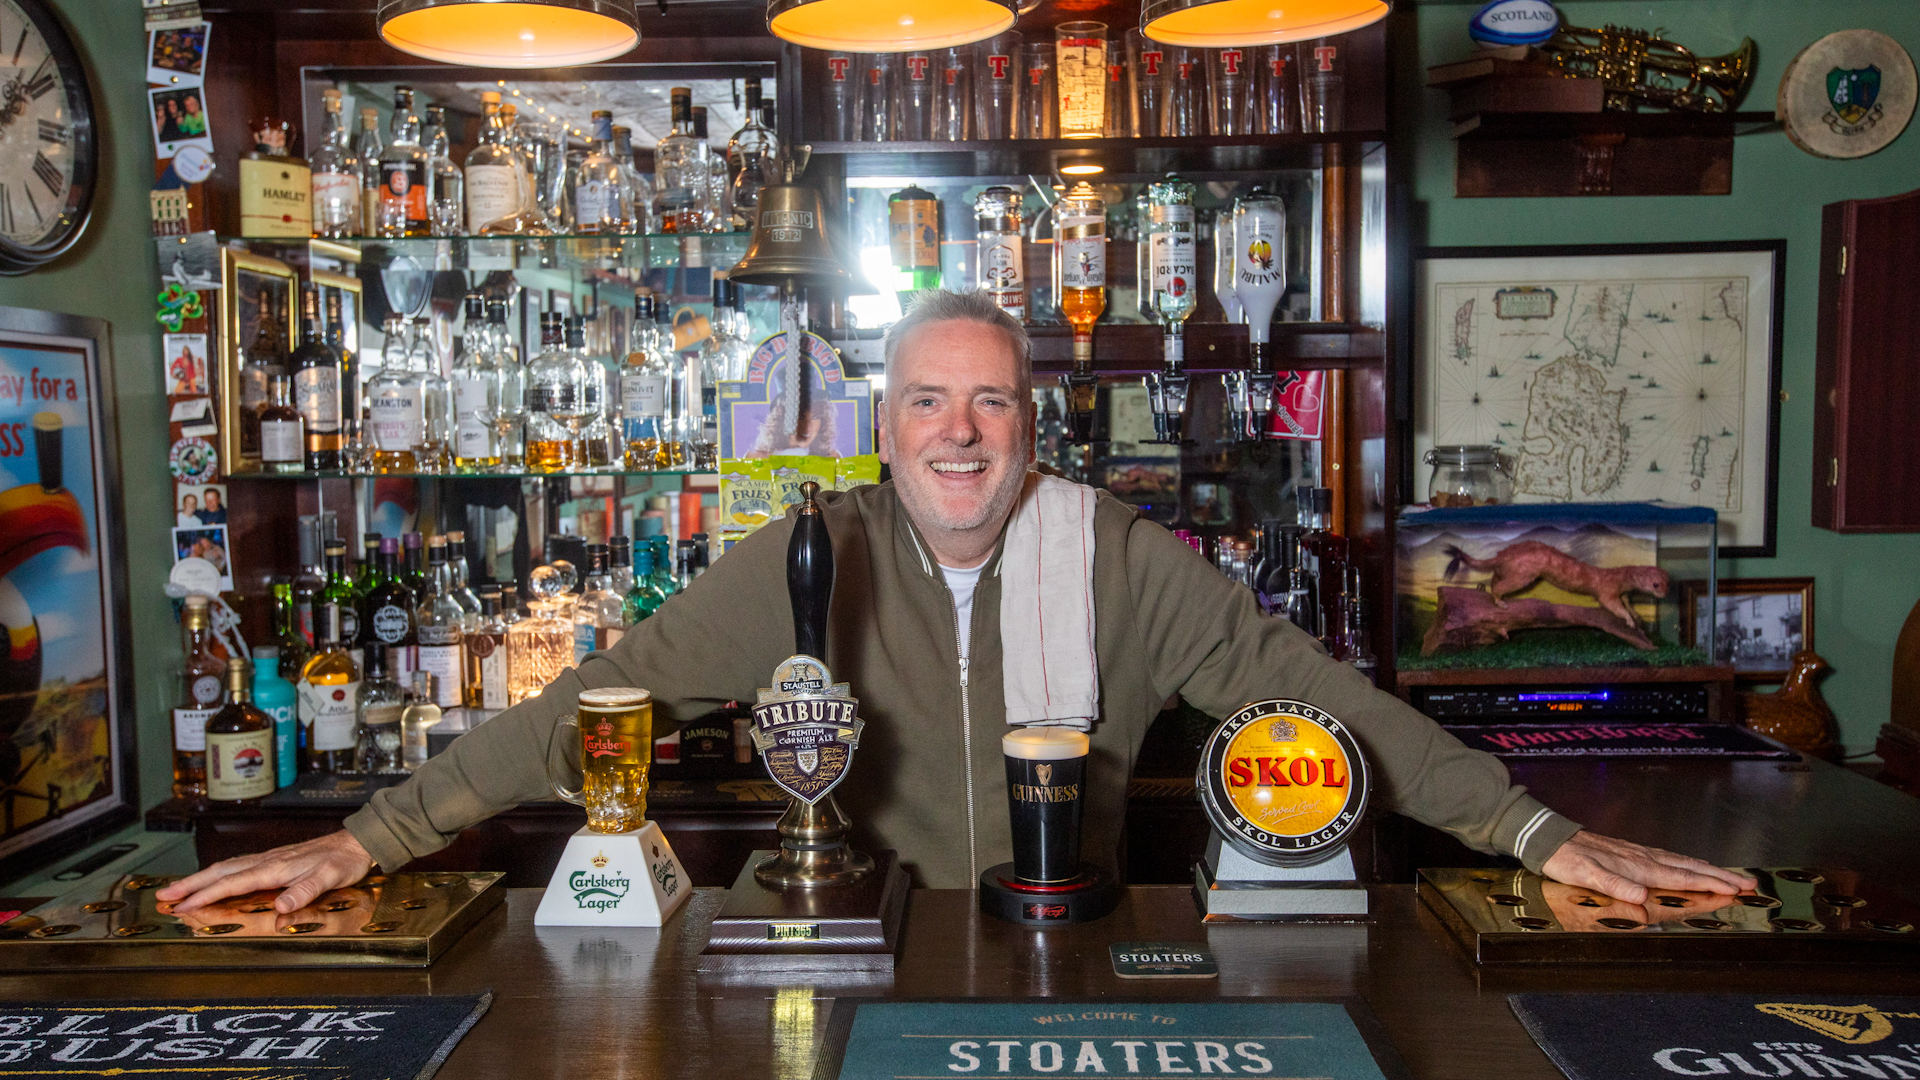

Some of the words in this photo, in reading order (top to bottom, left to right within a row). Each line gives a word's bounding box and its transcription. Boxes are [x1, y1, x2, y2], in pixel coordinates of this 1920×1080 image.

[1491, 10, 1553, 22] SCOTLAND
[907, 56, 929, 80] T
[988, 55, 1009, 80] T
[1141, 51, 1162, 76] T
[1221, 50, 1242, 75] T
[1271, 59, 1286, 77] T
[1314, 46, 1336, 72] T
[828, 57, 849, 82] T
[868, 68, 882, 85] T
[945, 68, 958, 85] T
[1028, 68, 1043, 85] T
[1107, 64, 1122, 82] T
[1179, 63, 1192, 80] T
[263, 188, 306, 203] HAMLET
[764, 211, 811, 226] TITANIC
[774, 231, 799, 240] 1912
[1240, 268, 1280, 284] MALIBU
[750, 347, 774, 384] BIG
[770, 336, 787, 355] D
[825, 368, 840, 383] D
[1276, 370, 1301, 394] I
[0, 375, 25, 407] ay
[30, 366, 62, 400] for
[66, 378, 78, 401] a
[735, 480, 770, 489] SCAMPI
[732, 489, 772, 500] FRIES
[756, 702, 854, 728] TRIBUTE
[1222, 706, 1265, 740] SKOL
[1276, 702, 1340, 735] LAGER
[684, 728, 730, 740] JAMESON
[778, 737, 816, 745] CORNISH
[787, 728, 824, 737] PREMIUM
[585, 735, 631, 752] Carlsberg
[1229, 756, 1346, 788] SKOL
[1012, 784, 1078, 803] GUINNESS
[1258, 804, 1298, 822] Served
[1298, 800, 1320, 813] Cool
[1232, 816, 1281, 846] SKOL
[1295, 811, 1354, 848] LAGER
[652, 858, 676, 884] Carlsberg
[569, 870, 630, 892] Carlsberg
[578, 896, 621, 914] Lager
[775, 925, 812, 937] PINT365
[1120, 954, 1204, 962] STOATERS
[1032, 1011, 1142, 1026] WELCOME
[1150, 1014, 1178, 1026] TO
[948, 1040, 1274, 1074] STOATERS
[1652, 1047, 1920, 1080] GUINN
